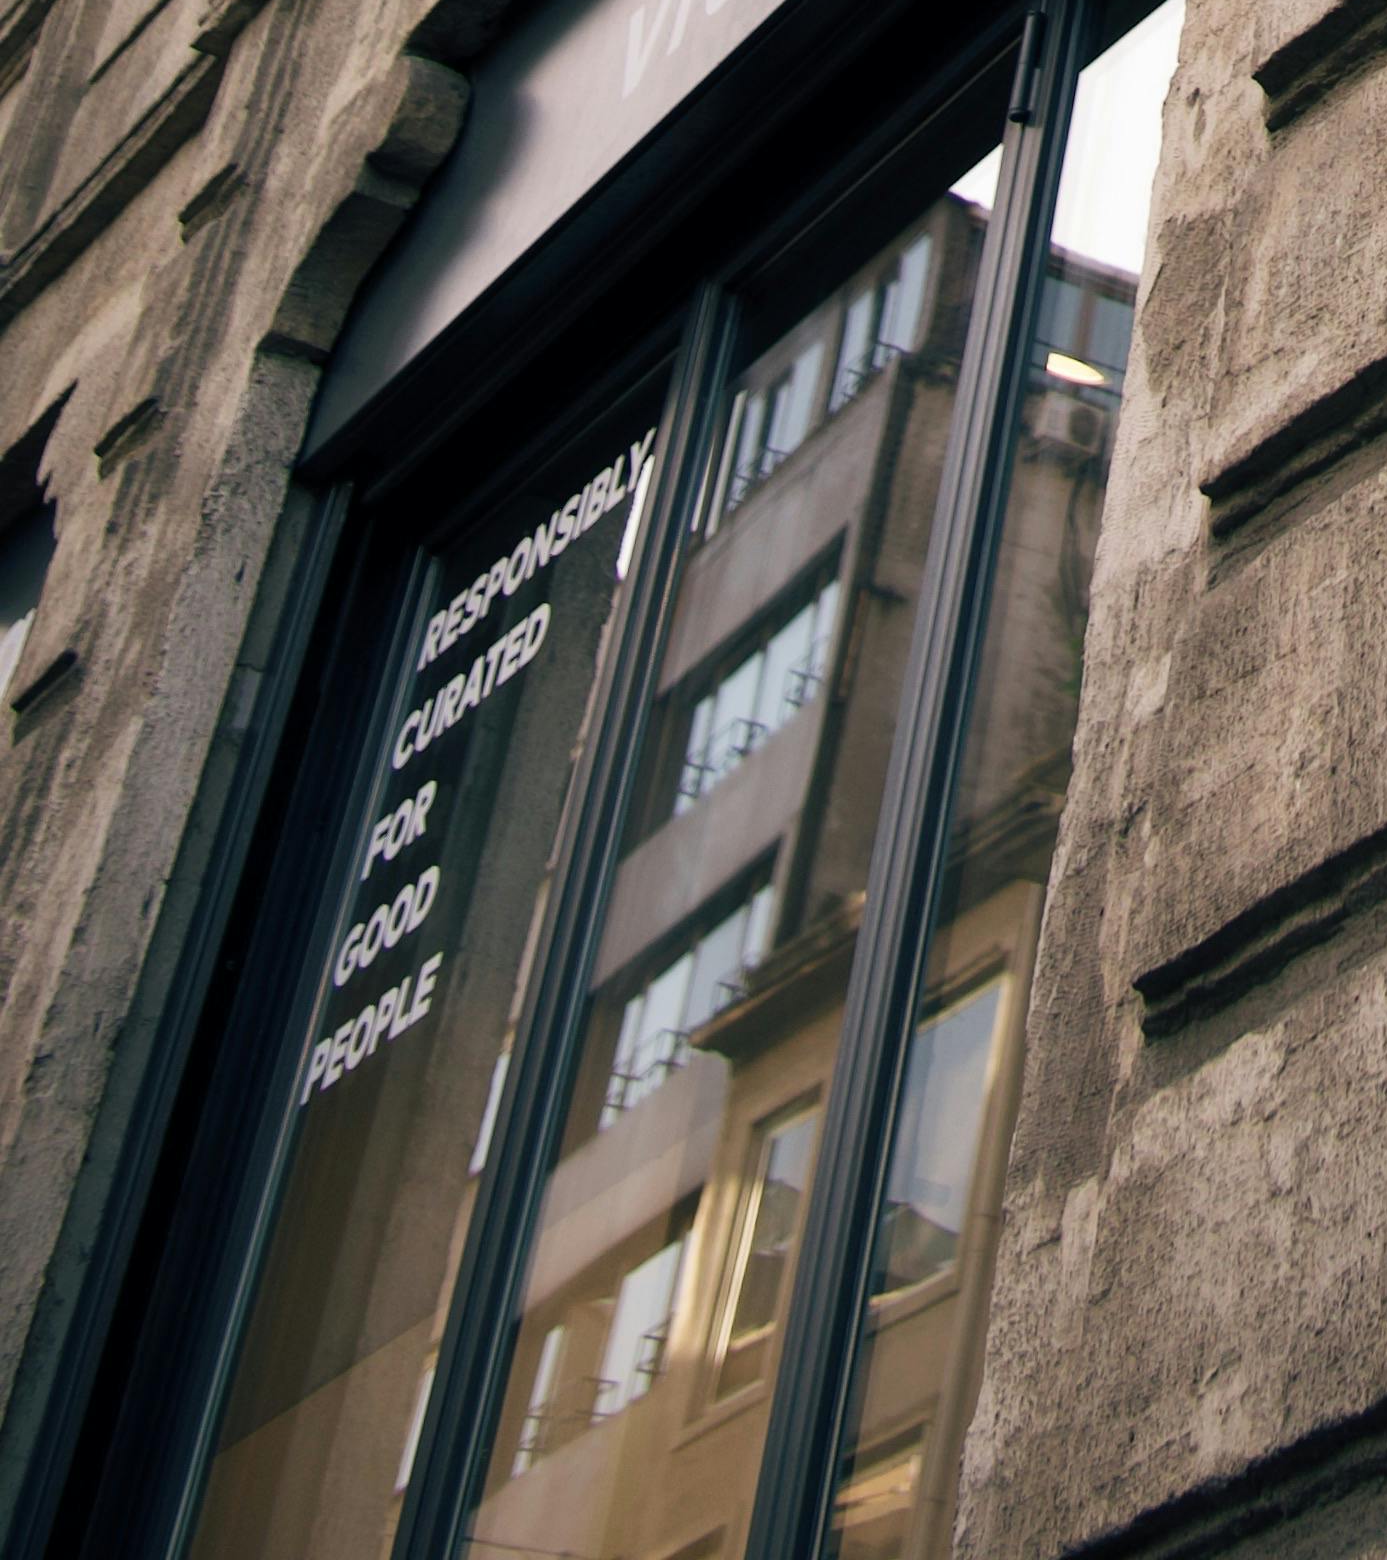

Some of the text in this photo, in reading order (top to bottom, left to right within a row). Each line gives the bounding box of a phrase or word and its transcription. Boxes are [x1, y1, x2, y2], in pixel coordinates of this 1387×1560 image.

[418, 428, 656, 671] RESPONSIBLY
[392, 604, 551, 769] CURATED
[361, 781, 437, 880] FOR
[334, 866, 440, 987] GOOD
[300, 953, 443, 1105] PEOPLE
